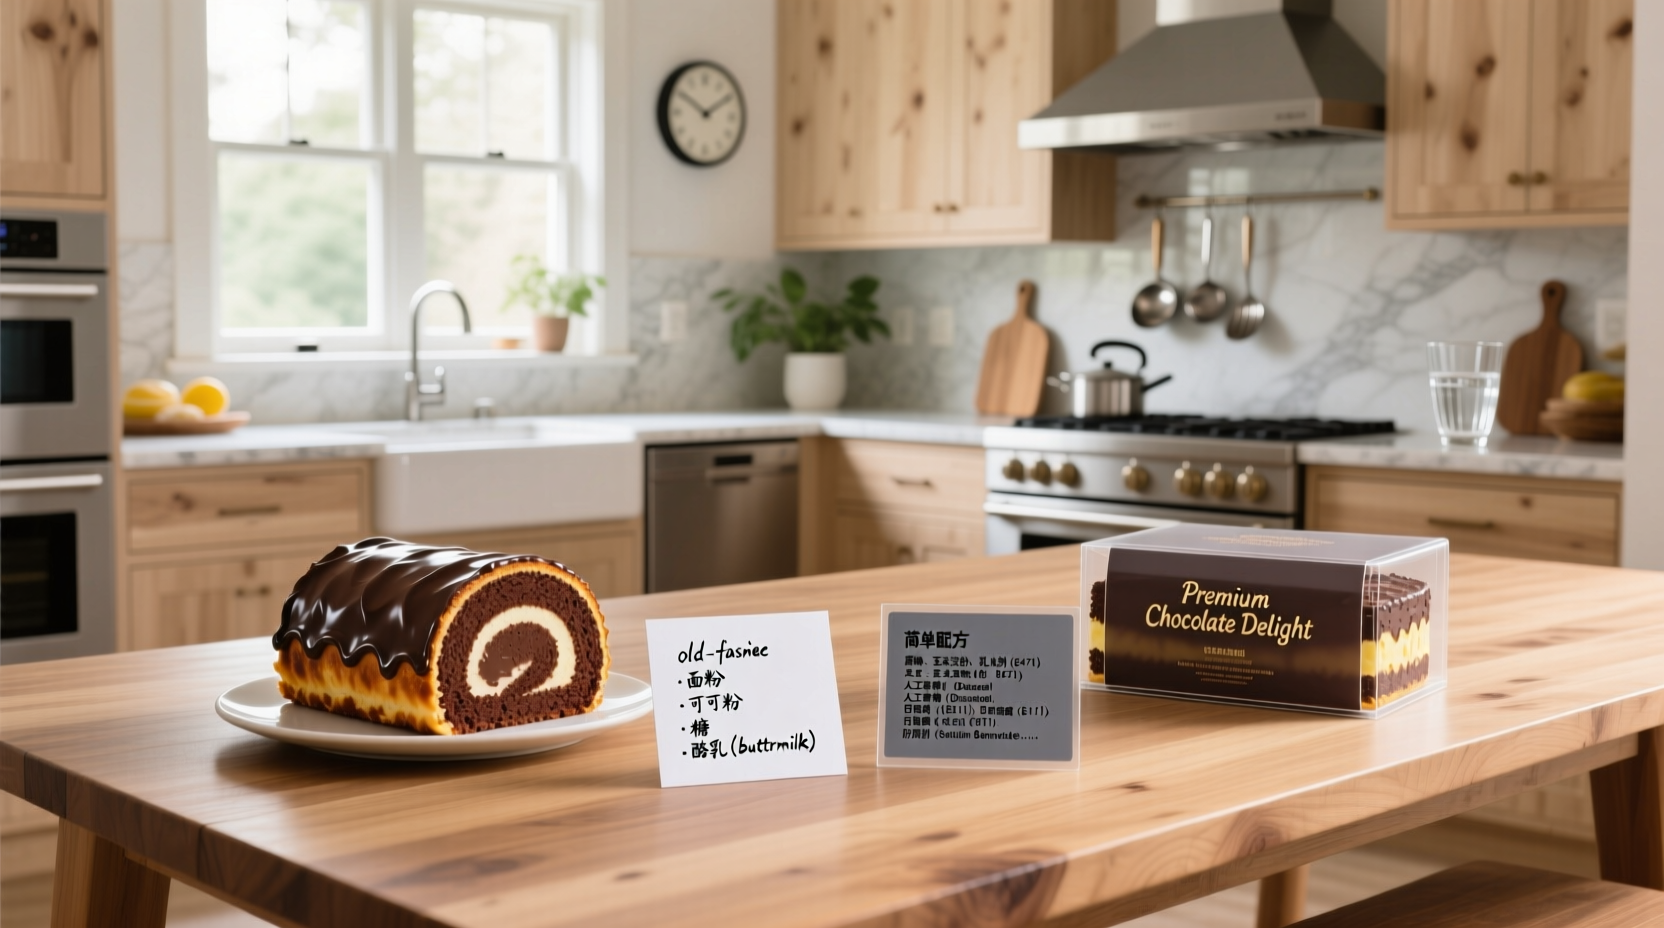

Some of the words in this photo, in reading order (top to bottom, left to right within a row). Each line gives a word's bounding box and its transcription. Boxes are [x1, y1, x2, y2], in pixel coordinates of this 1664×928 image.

[1181, 580, 1270, 609] Premium
[1144, 603, 1237, 635] Chocolate
[1240, 612, 1314, 646] Delight
[687, 669, 725, 689] 面粉
[688, 692, 743, 713] 可可粉
[689, 717, 710, 738] 糖
